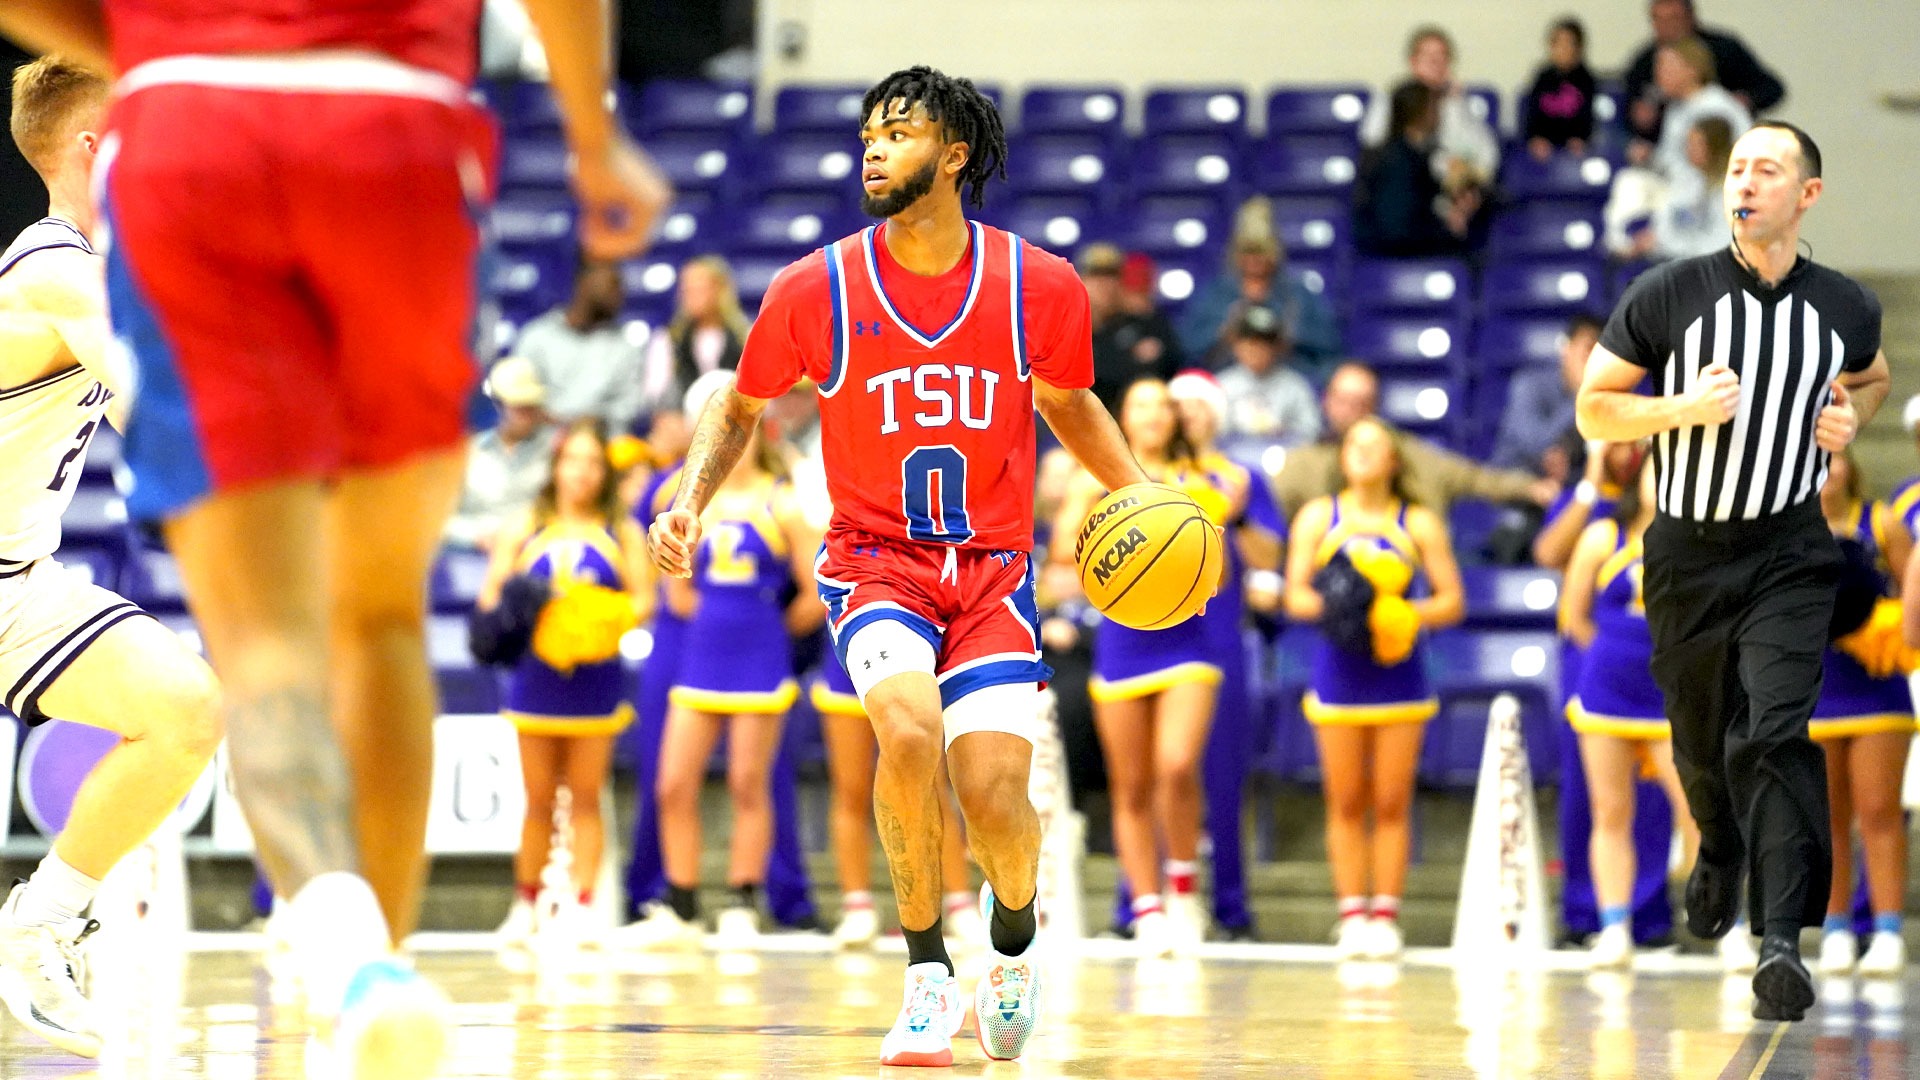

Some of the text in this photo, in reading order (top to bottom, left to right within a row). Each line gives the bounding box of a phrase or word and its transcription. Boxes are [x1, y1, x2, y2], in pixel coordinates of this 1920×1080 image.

[866, 363, 1000, 435] TSU
[901, 444, 976, 545] 0
[1074, 496, 1140, 564] Wilson
[1092, 527, 1148, 587] NCAA
